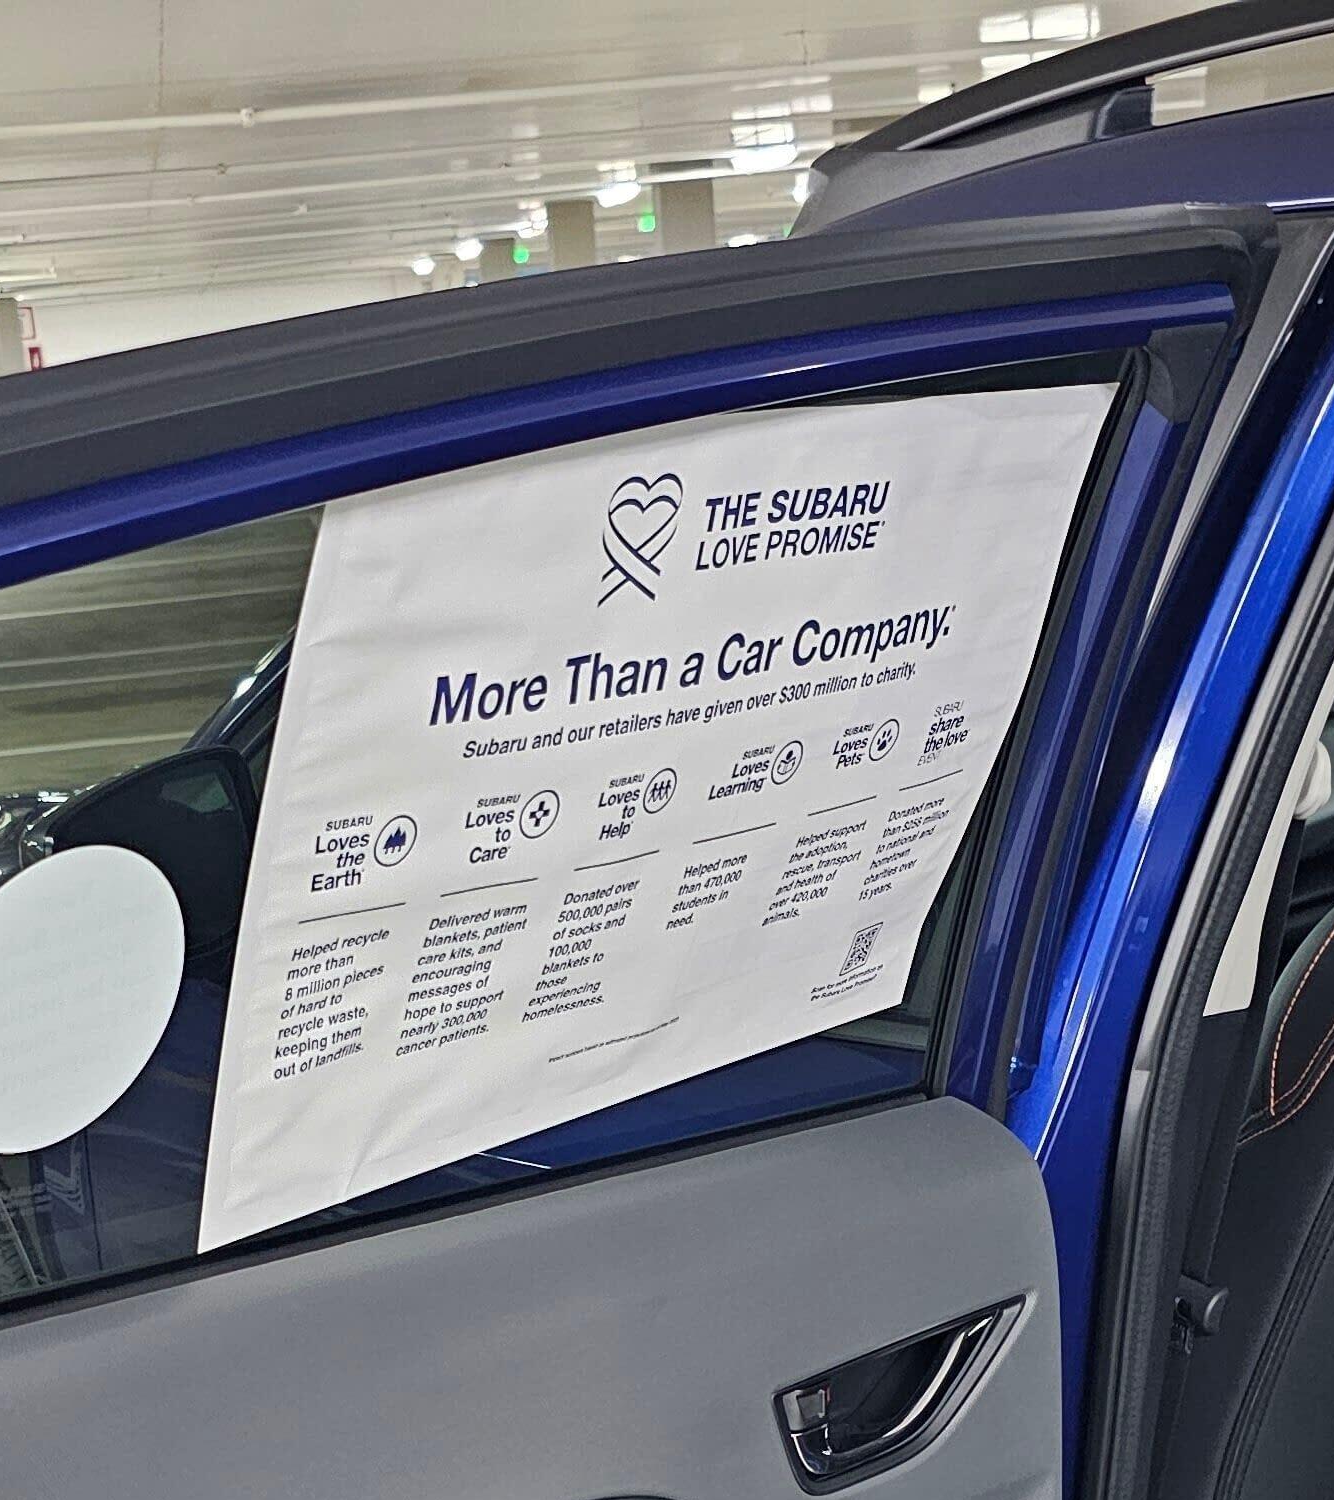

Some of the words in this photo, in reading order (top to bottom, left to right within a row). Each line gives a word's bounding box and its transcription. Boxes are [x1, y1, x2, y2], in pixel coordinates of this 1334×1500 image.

[705, 492, 762, 532] THE
[768, 481, 890, 521] SUBARU
[695, 531, 758, 570] LOVE
[765, 522, 879, 560] PROMISE
[429, 672, 547, 725] More
[566, 652, 667, 705] Than
[679, 652, 705, 688] a
[717, 632, 784, 681] Car
[793, 606, 951, 666] Company.
[463, 736, 528, 759] Subaru
[532, 727, 564, 750] and
[567, 725, 595, 744] our
[599, 713, 661, 739] retailers
[665, 705, 700, 727] have
[704, 699, 743, 723] given
[746, 691, 776, 711] over
[779, 681, 811, 704] $300
[813, 674, 857, 697] million
[861, 671, 873, 687] to
[876, 661, 916, 684] charity.
[843, 723, 874, 738] SUBARU
[928, 715, 965, 736] share
[742, 745, 776, 760] SUBARU
[832, 737, 869, 756] Loves
[924, 735, 944, 754] the
[944, 729, 968, 748] love
[731, 760, 770, 779] Loves
[835, 753, 863, 770] Pets
[609, 773, 645, 789] SUBARU
[708, 777, 765, 801] Learning
[477, 794, 521, 809] SUBARU
[598, 788, 640, 808] Loves
[325, 815, 374, 832] SUBARU
[465, 808, 515, 830] Loves
[621, 803, 636, 820] to
[495, 827, 511, 843] to
[599, 820, 631, 841] Help
[796, 829, 830, 849] Helped
[830, 819, 867, 839] support
[882, 826, 901, 839] than
[315, 833, 370, 855] Loves
[469, 845, 508, 864] Care
[876, 844, 885, 855] to
[885, 831, 919, 851] national
[336, 852, 365, 869] the
[683, 859, 722, 879] Helped
[721, 854, 748, 869] more
[781, 863, 814, 880] rescue,
[817, 850, 862, 870] transport
[789, 852, 805, 864] the
[311, 870, 361, 892] Earth
[678, 882, 702, 896] than
[704, 869, 743, 889] 470,000
[776, 880, 795, 896] and
[794, 873, 823, 890] health
[826, 869, 838, 882] of
[863, 866, 897, 886] charities
[563, 884, 615, 906] Donated
[615, 880, 640, 895] over
[672, 893, 718, 913] students
[718, 889, 729, 901] in
[769, 897, 790, 911] over
[428, 908, 492, 931] Delivered
[493, 904, 528, 919] warm
[557, 903, 604, 923] 500,000
[603, 898, 633, 917] pairs
[666, 912, 694, 931] need.
[422, 929, 481, 949] blankets,
[483, 918, 528, 941] patient
[552, 927, 567, 941] of
[567, 921, 602, 939] socks
[603, 914, 627, 930] and
[291, 937, 340, 962] Helped
[341, 928, 390, 949] recycle
[417, 952, 447, 966] care
[449, 948, 475, 961] kits,
[477, 939, 504, 955] and
[548, 938, 593, 958] 100,000
[287, 963, 322, 981] more
[325, 954, 354, 972] than
[411, 960, 492, 984] encouraging
[541, 956, 591, 976] blankets
[592, 952, 605, 963] to
[284, 987, 293, 1002] 8
[296, 977, 341, 1000] million
[342, 964, 385, 989] pieces
[407, 981, 473, 1003] messages
[475, 975, 490, 989] of
[528, 981, 602, 1007] experiencing
[535, 976, 568, 992] those
[280, 1005, 295, 1020] of
[297, 997, 328, 1016] hard
[330, 993, 343, 1006] to
[403, 1006, 437, 1022] hope
[440, 1002, 453, 1014] to
[455, 990, 505, 1011] support
[521, 994, 605, 1023] homelessness.
[277, 1016, 324, 1041] recycle
[328, 1005, 369, 1026] waste,
[399, 1021, 440, 1040] nearly
[441, 1008, 489, 1030] 300,000
[274, 1035, 328, 1060] keeping
[331, 1025, 362, 1045] them
[395, 1036, 437, 1057] cancer
[438, 1023, 489, 1048] patients.
[273, 1063, 296, 1080] out
[299, 1058, 314, 1073] of
[315, 1042, 364, 1068] landfills.
